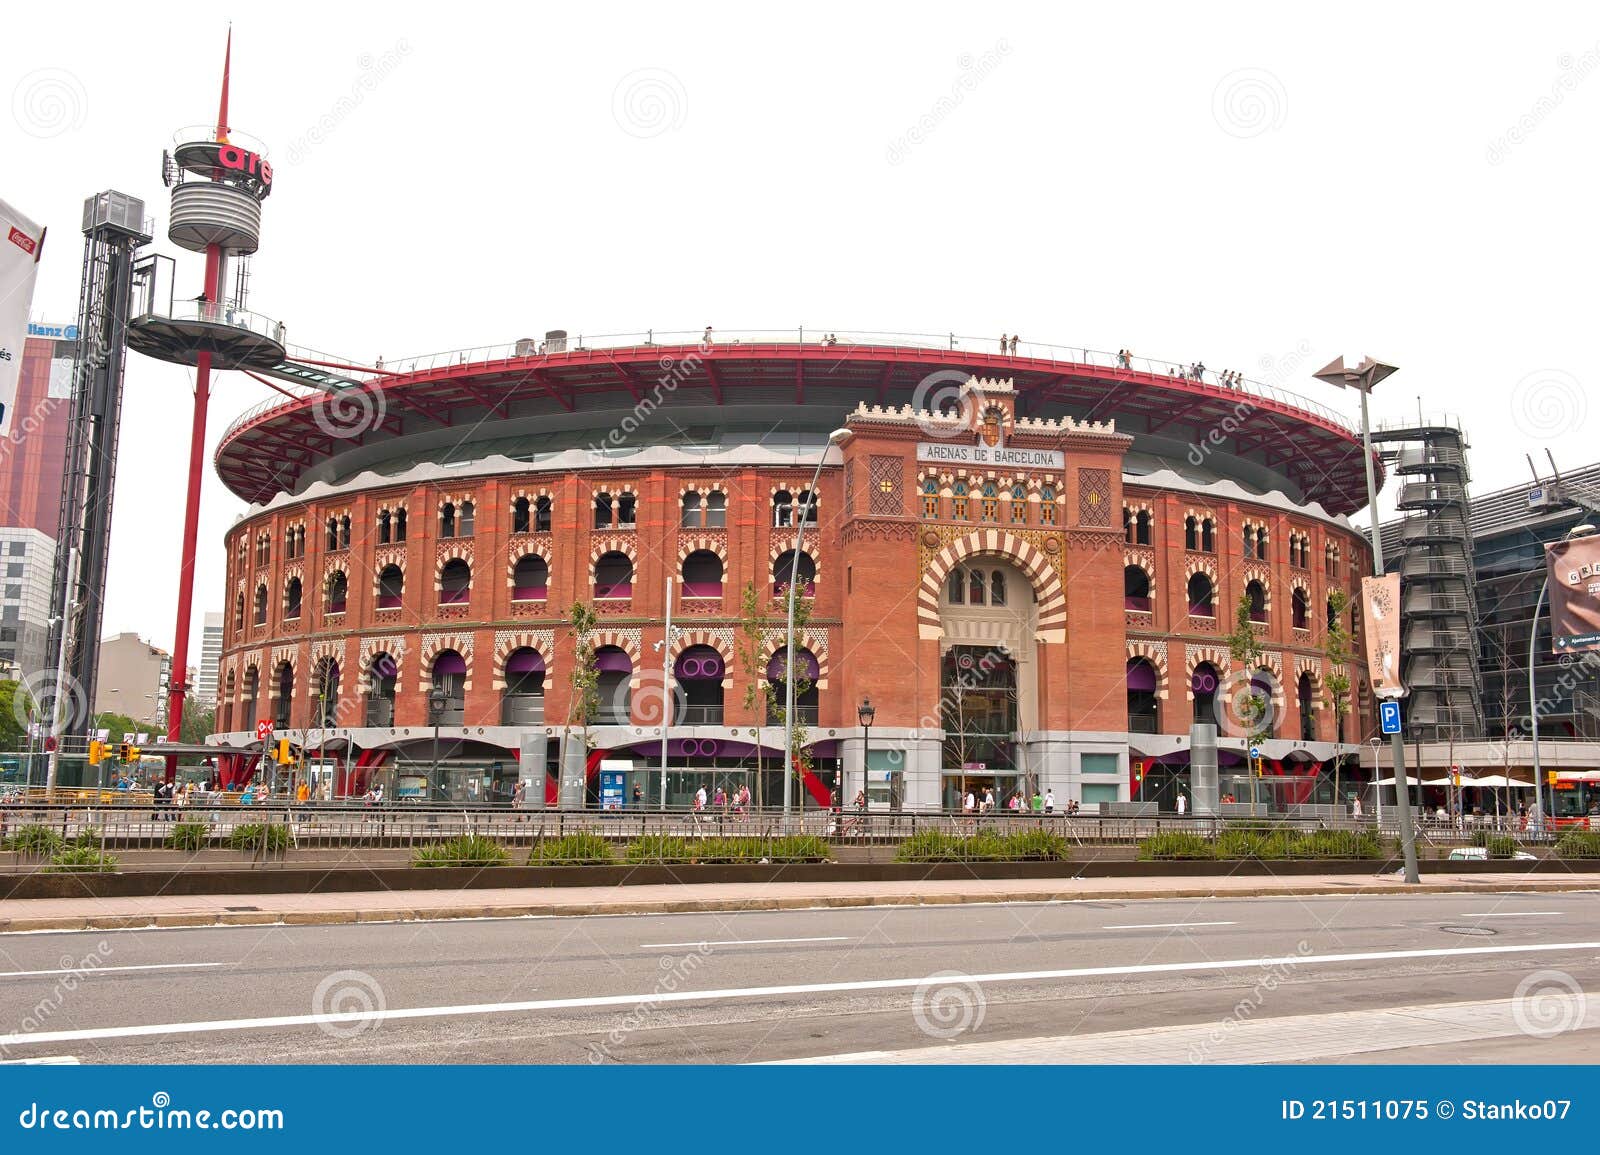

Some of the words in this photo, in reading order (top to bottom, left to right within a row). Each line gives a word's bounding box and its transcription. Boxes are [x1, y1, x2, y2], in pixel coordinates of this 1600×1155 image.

[927, 446, 968, 460] ARENAS
[974, 449, 988, 462] DE
[994, 450, 1055, 465] BARCELONA
[1385, 707, 1395, 722] P
